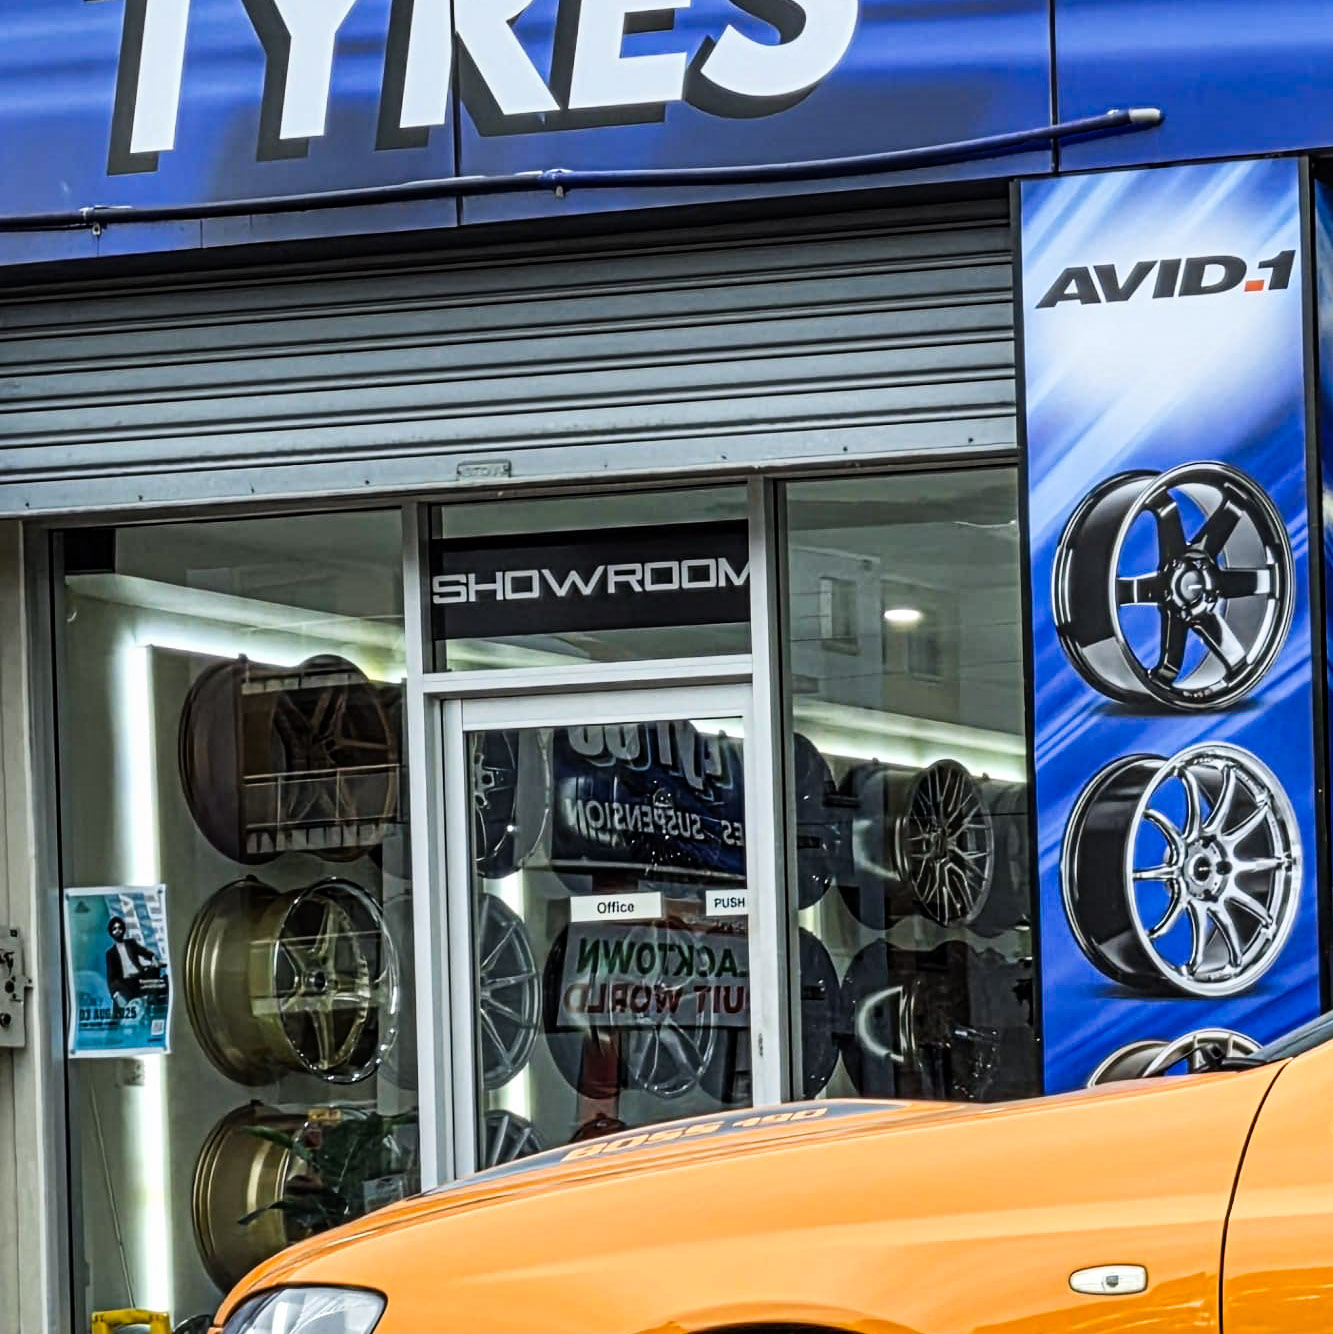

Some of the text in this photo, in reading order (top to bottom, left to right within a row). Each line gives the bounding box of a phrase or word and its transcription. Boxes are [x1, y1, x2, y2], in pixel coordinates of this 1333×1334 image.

[1034, 249, 1297, 309] AVID.1
[432, 557, 750, 605] SHOWROOM
[596, 901, 635, 915] Office
[714, 897, 745, 909] PUSH
